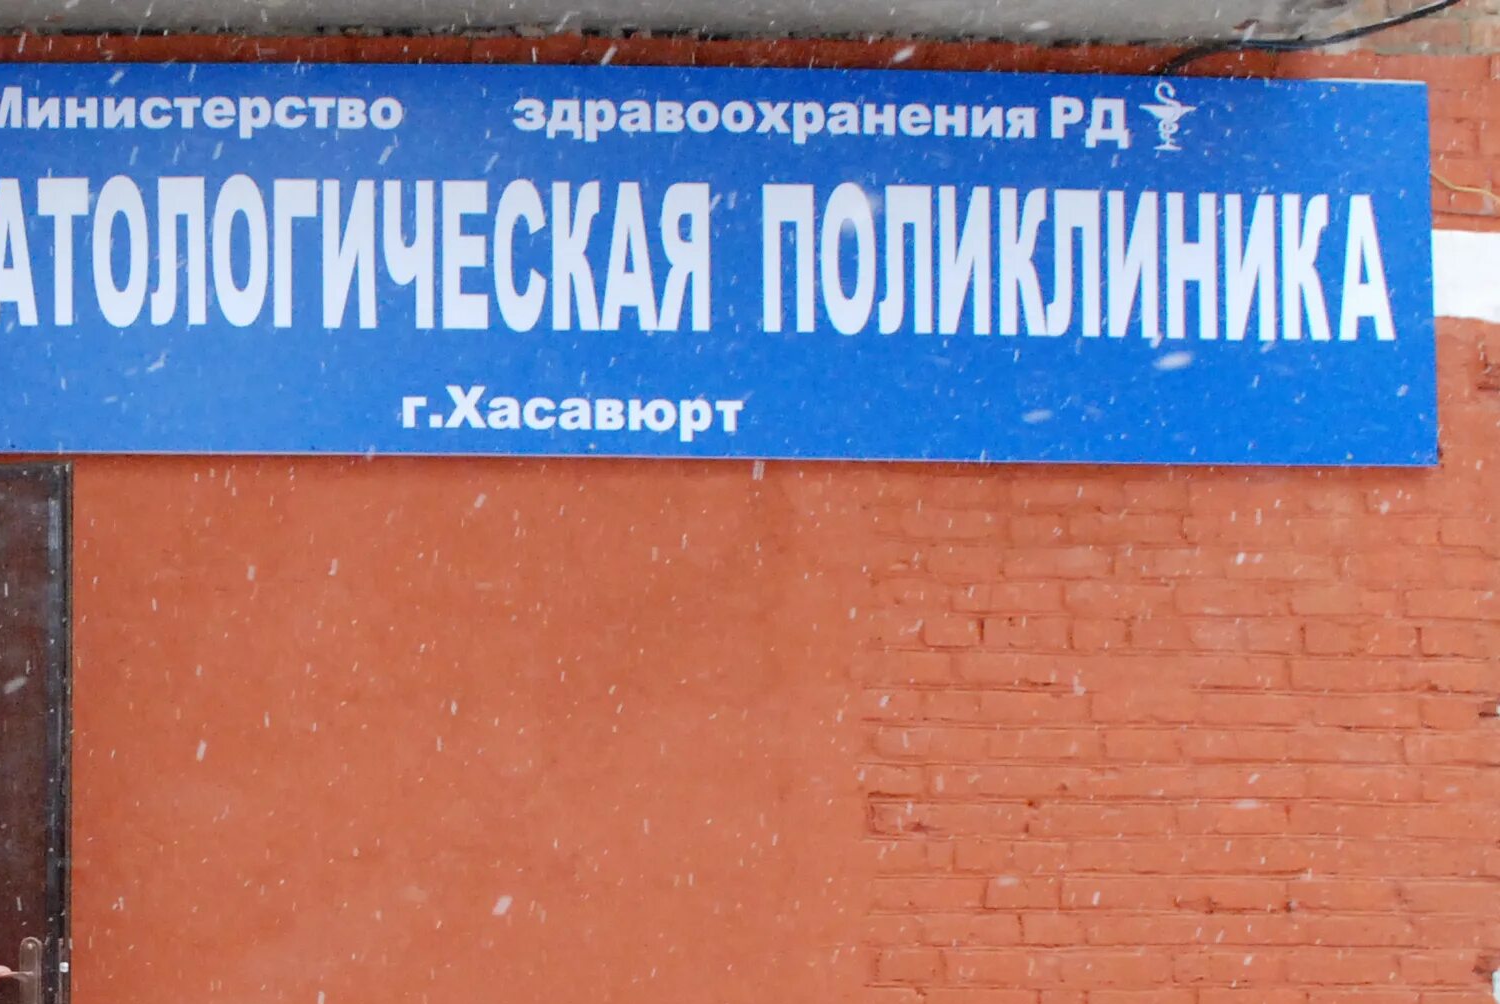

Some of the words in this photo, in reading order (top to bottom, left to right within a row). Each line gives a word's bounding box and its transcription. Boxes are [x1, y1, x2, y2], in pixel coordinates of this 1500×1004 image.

[514, 98, 1036, 143] здравоохранения
[1052, 96, 1130, 149] РД
[763, 182, 1397, 343] ПОЛИКЛИНИКА
[402, 384, 744, 443] г.Хасавюрт
